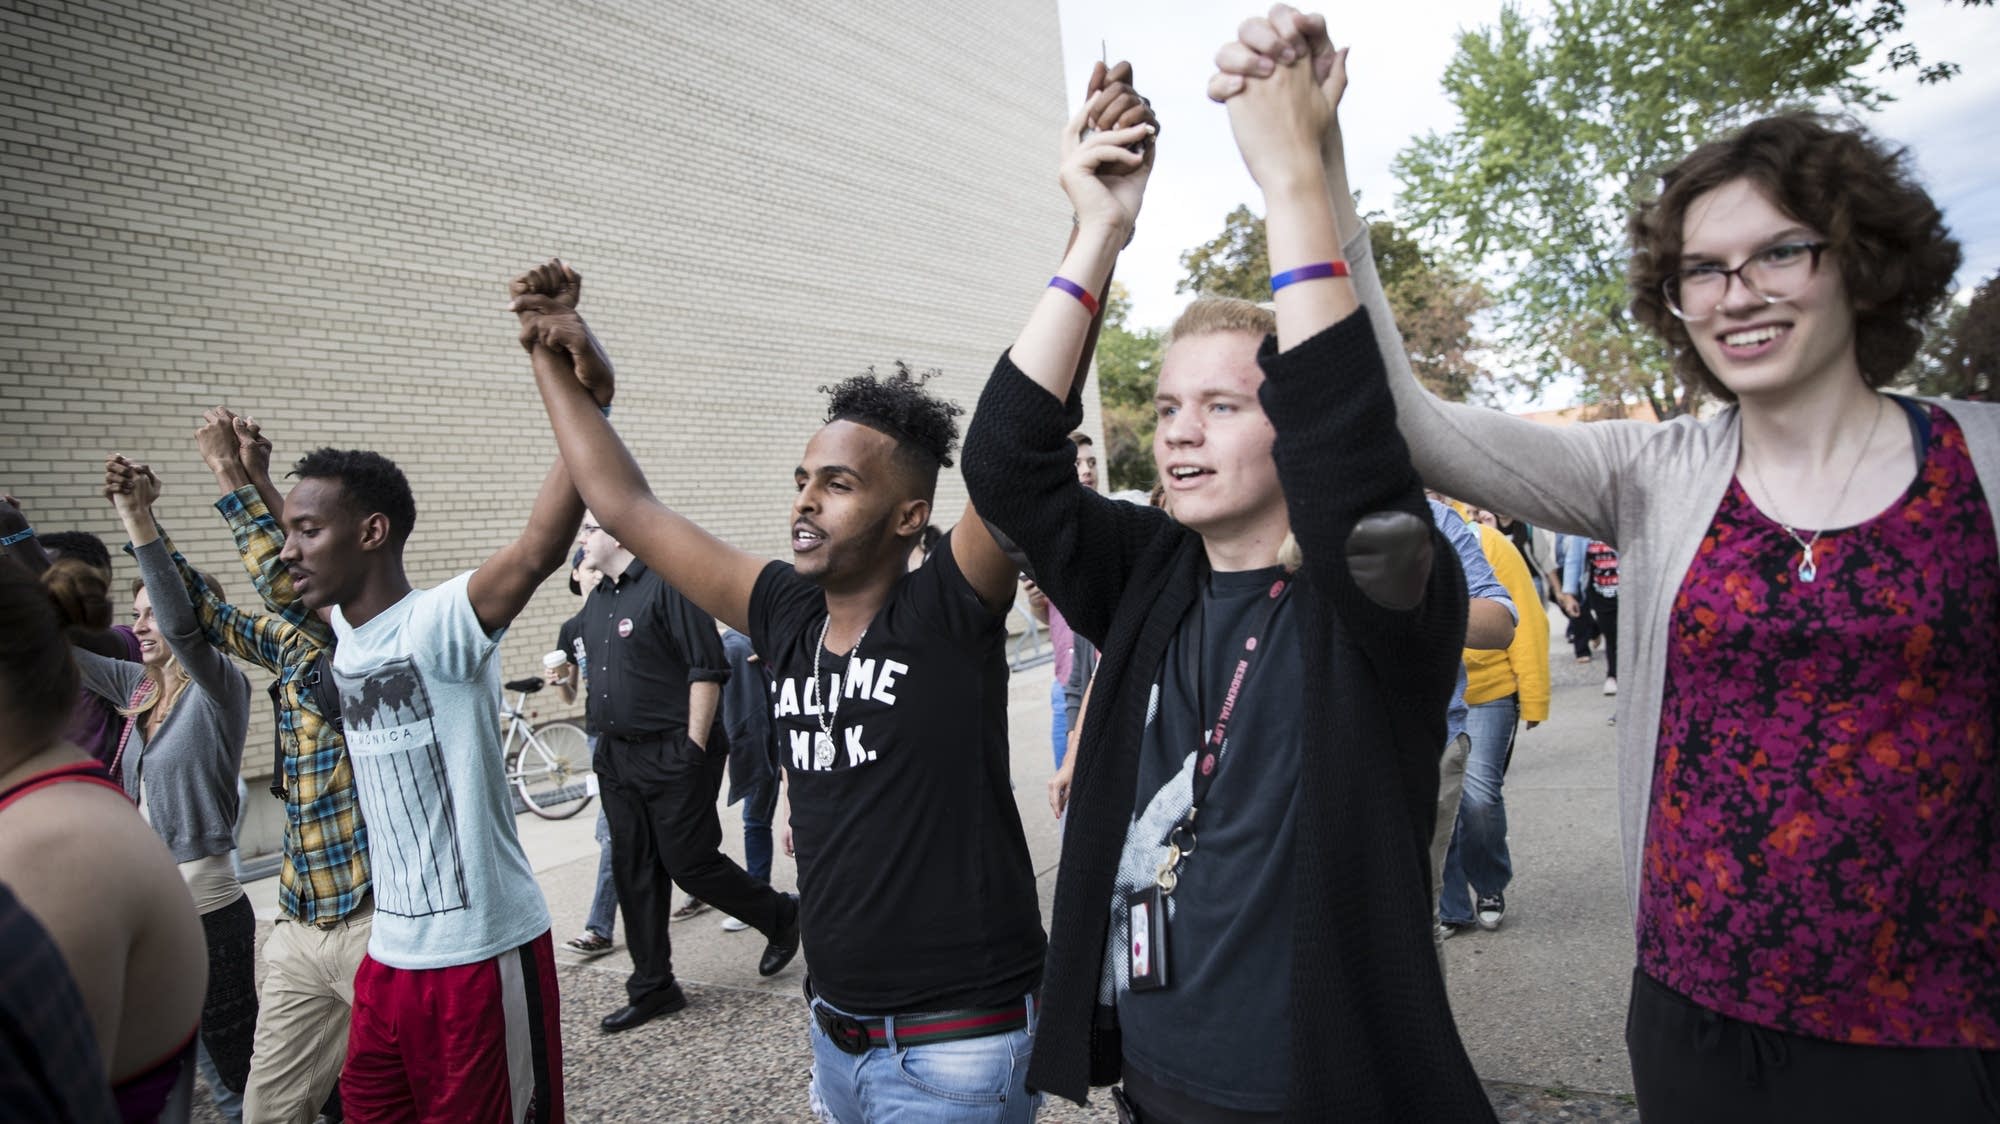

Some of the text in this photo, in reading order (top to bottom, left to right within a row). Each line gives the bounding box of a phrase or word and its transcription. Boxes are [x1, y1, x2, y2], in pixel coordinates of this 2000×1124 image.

[845, 657, 909, 706] ME
[1219, 659, 1249, 721] RESIDENTIAL
[845, 724, 878, 768] K.
[1211, 722, 1227, 746] LIFE
